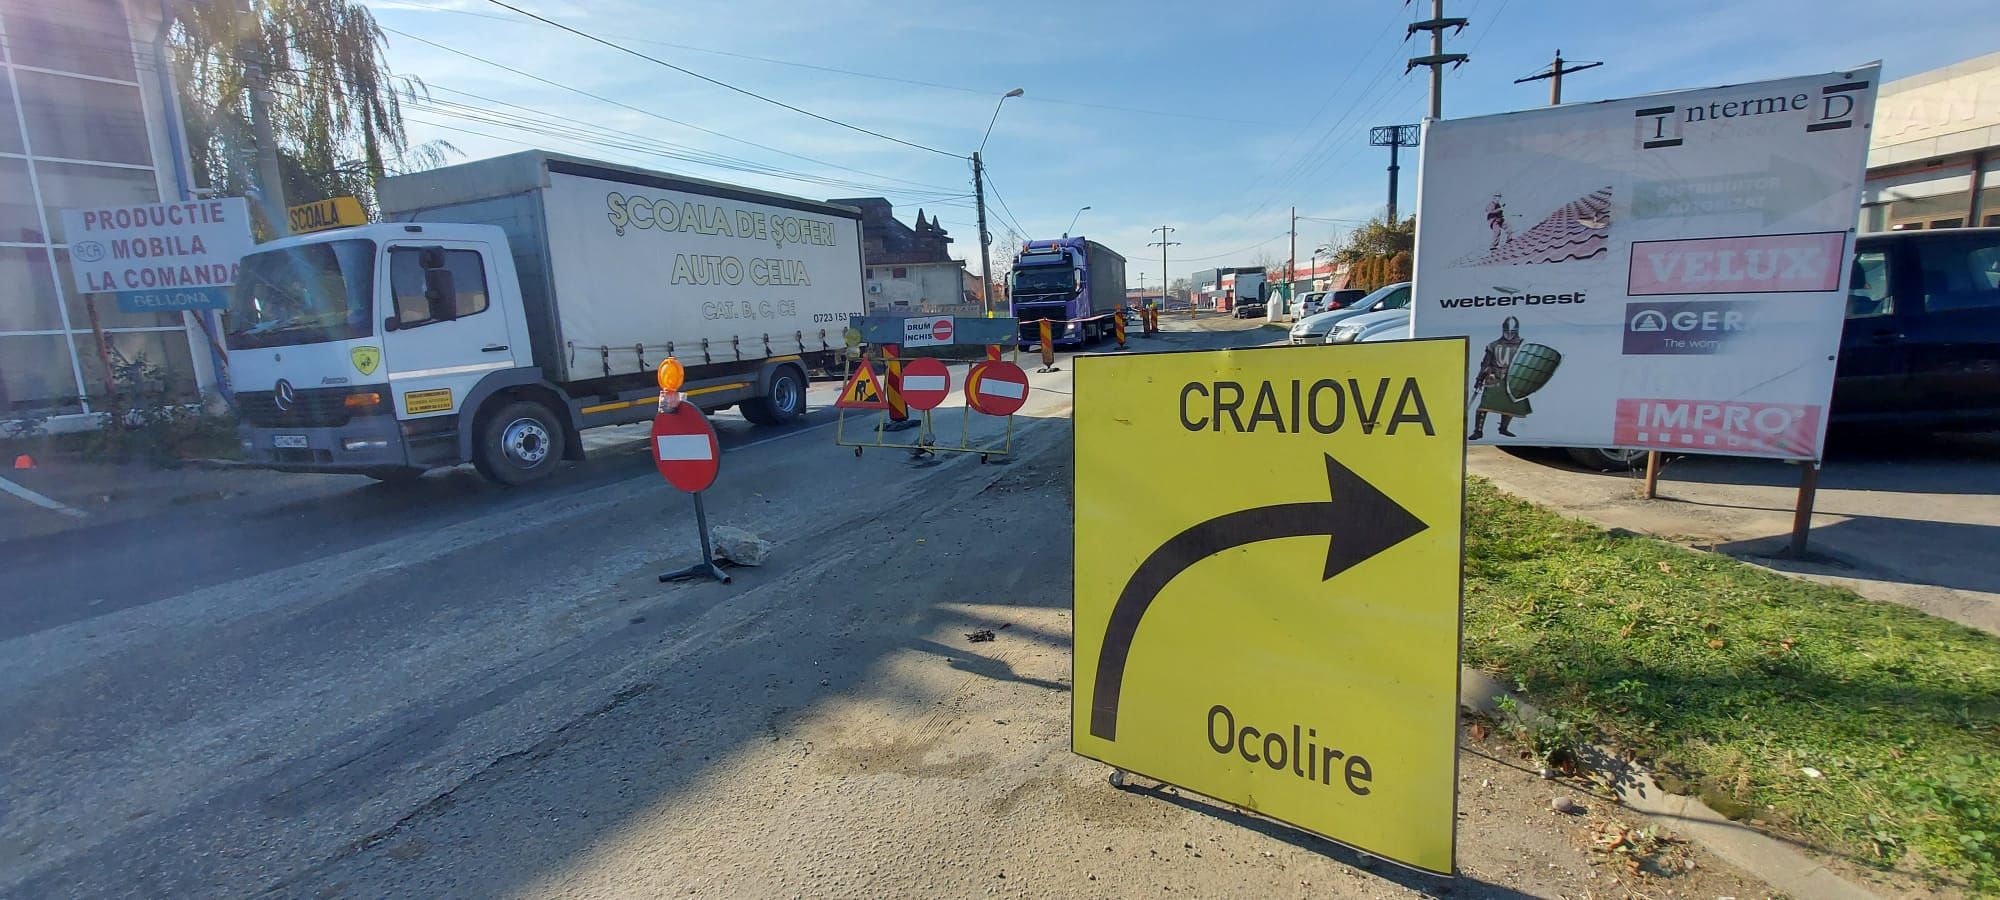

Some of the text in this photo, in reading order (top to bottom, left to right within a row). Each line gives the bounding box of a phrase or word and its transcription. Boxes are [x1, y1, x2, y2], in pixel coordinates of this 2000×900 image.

[83, 202, 225, 231] PRODUCTIE
[736, 210, 767, 240] DE
[111, 235, 207, 259] MOBILA
[86, 263, 240, 292] LA COMANDA
[671, 254, 812, 286] AUTO CELIA
[1648, 247, 1822, 284] VELUX
[134, 291, 210, 306] BELLONA
[702, 301, 739, 320] CAT.
[777, 299, 796, 317] CE
[1440, 291, 1585, 309] wetterbest
[813, 312, 833, 323] 0723
[835, 312, 847, 321] 153
[907, 322, 931, 331] DRUM
[1663, 338, 1685, 348] The
[1179, 376, 1436, 436] CRAIOVA
[1207, 704, 1373, 796] Ocolire
